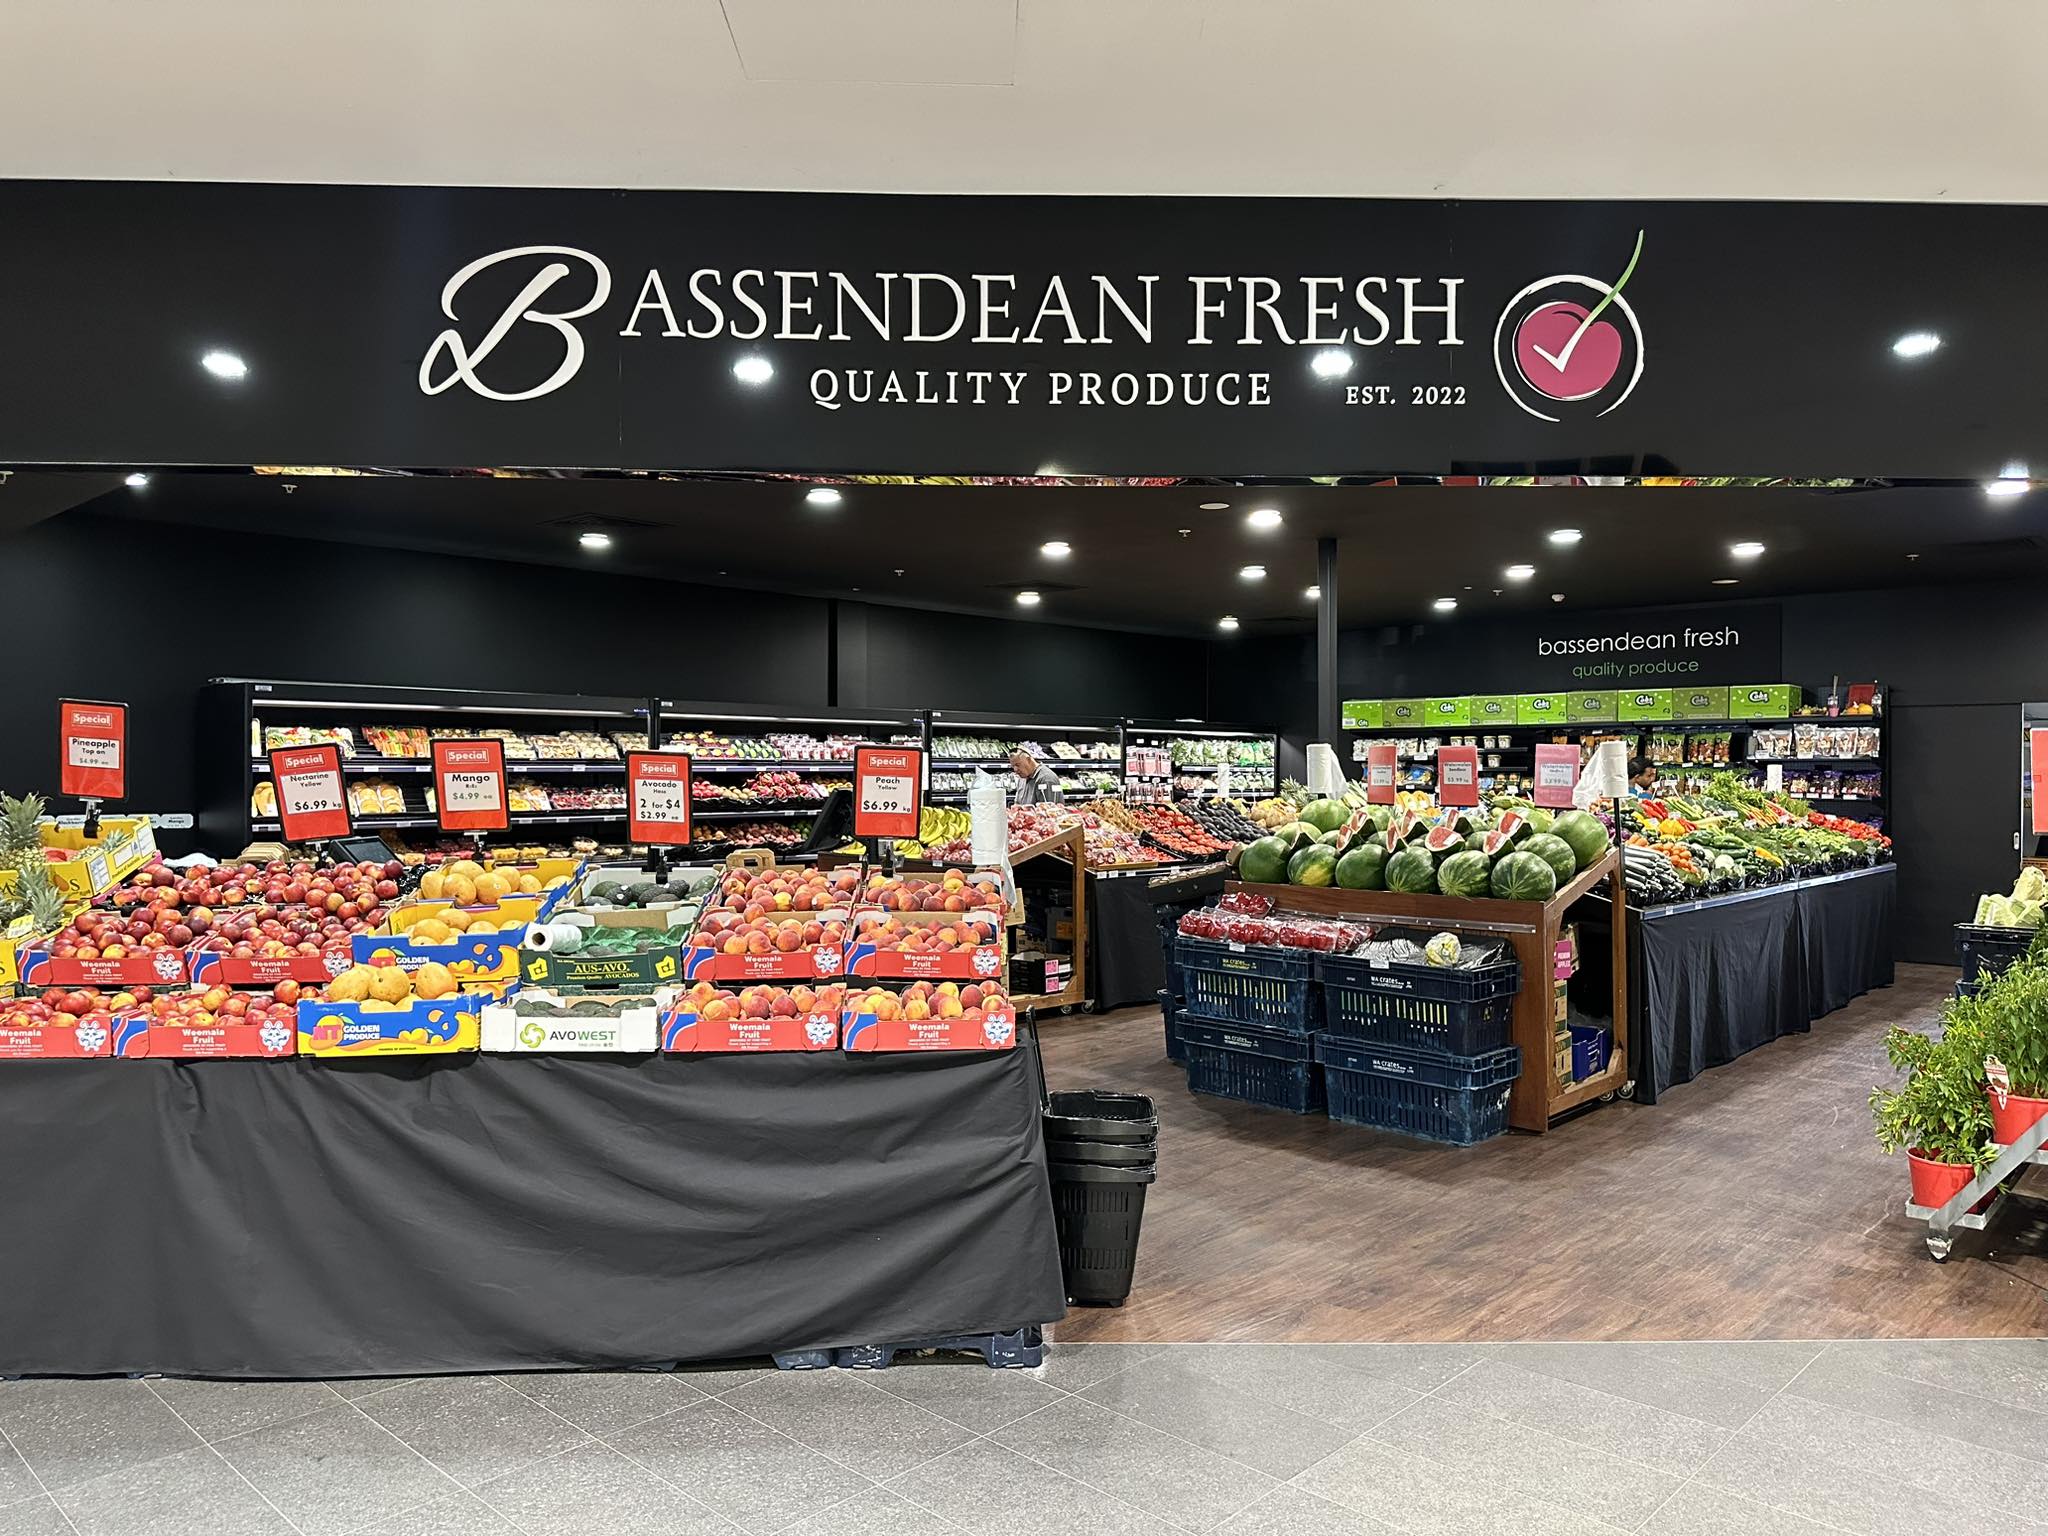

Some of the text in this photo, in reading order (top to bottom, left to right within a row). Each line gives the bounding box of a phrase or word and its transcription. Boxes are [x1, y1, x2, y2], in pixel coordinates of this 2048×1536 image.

[418, 246, 1465, 401] BASSENDEAN FRESH
[811, 368, 1271, 410] QUALITY PRODUCE
[1345, 386, 1466, 405] EST. 2022
[1538, 626, 1739, 656] bassendean fresh
[1572, 659, 1699, 680] quality produce
[73, 712, 110, 726] Special
[72, 738, 116, 749] Pineapple
[285, 754, 324, 768] Special
[448, 750, 487, 762] Special
[870, 756, 906, 768] Special
[642, 763, 677, 775] Special
[290, 773, 329, 782] Nectarine
[452, 774, 490, 784] Mango
[641, 780, 678, 788] Avocado
[452, 792, 480, 800] $4.99
[294, 800, 328, 811] $6.99
[640, 798, 647, 808] 2
[666, 798, 680, 810] $4
[863, 800, 898, 811] $6.99
[640, 810, 667, 820] $2.99
[396, 956, 430, 964] GOLDEN
[574, 962, 630, 974] AUS-AVO.
[182, 1028, 225, 1036] Weemala
[343, 1024, 380, 1033] GOLDEN
[740, 1030, 760, 1038] Fruit
[918, 1030, 940, 1038] Fruit
[10, 1036, 32, 1044] Fruit
[192, 1036, 214, 1044] Fruit
[343, 1032, 380, 1040] PRODUCE
[549, 1030, 616, 1040] AVOWEST
